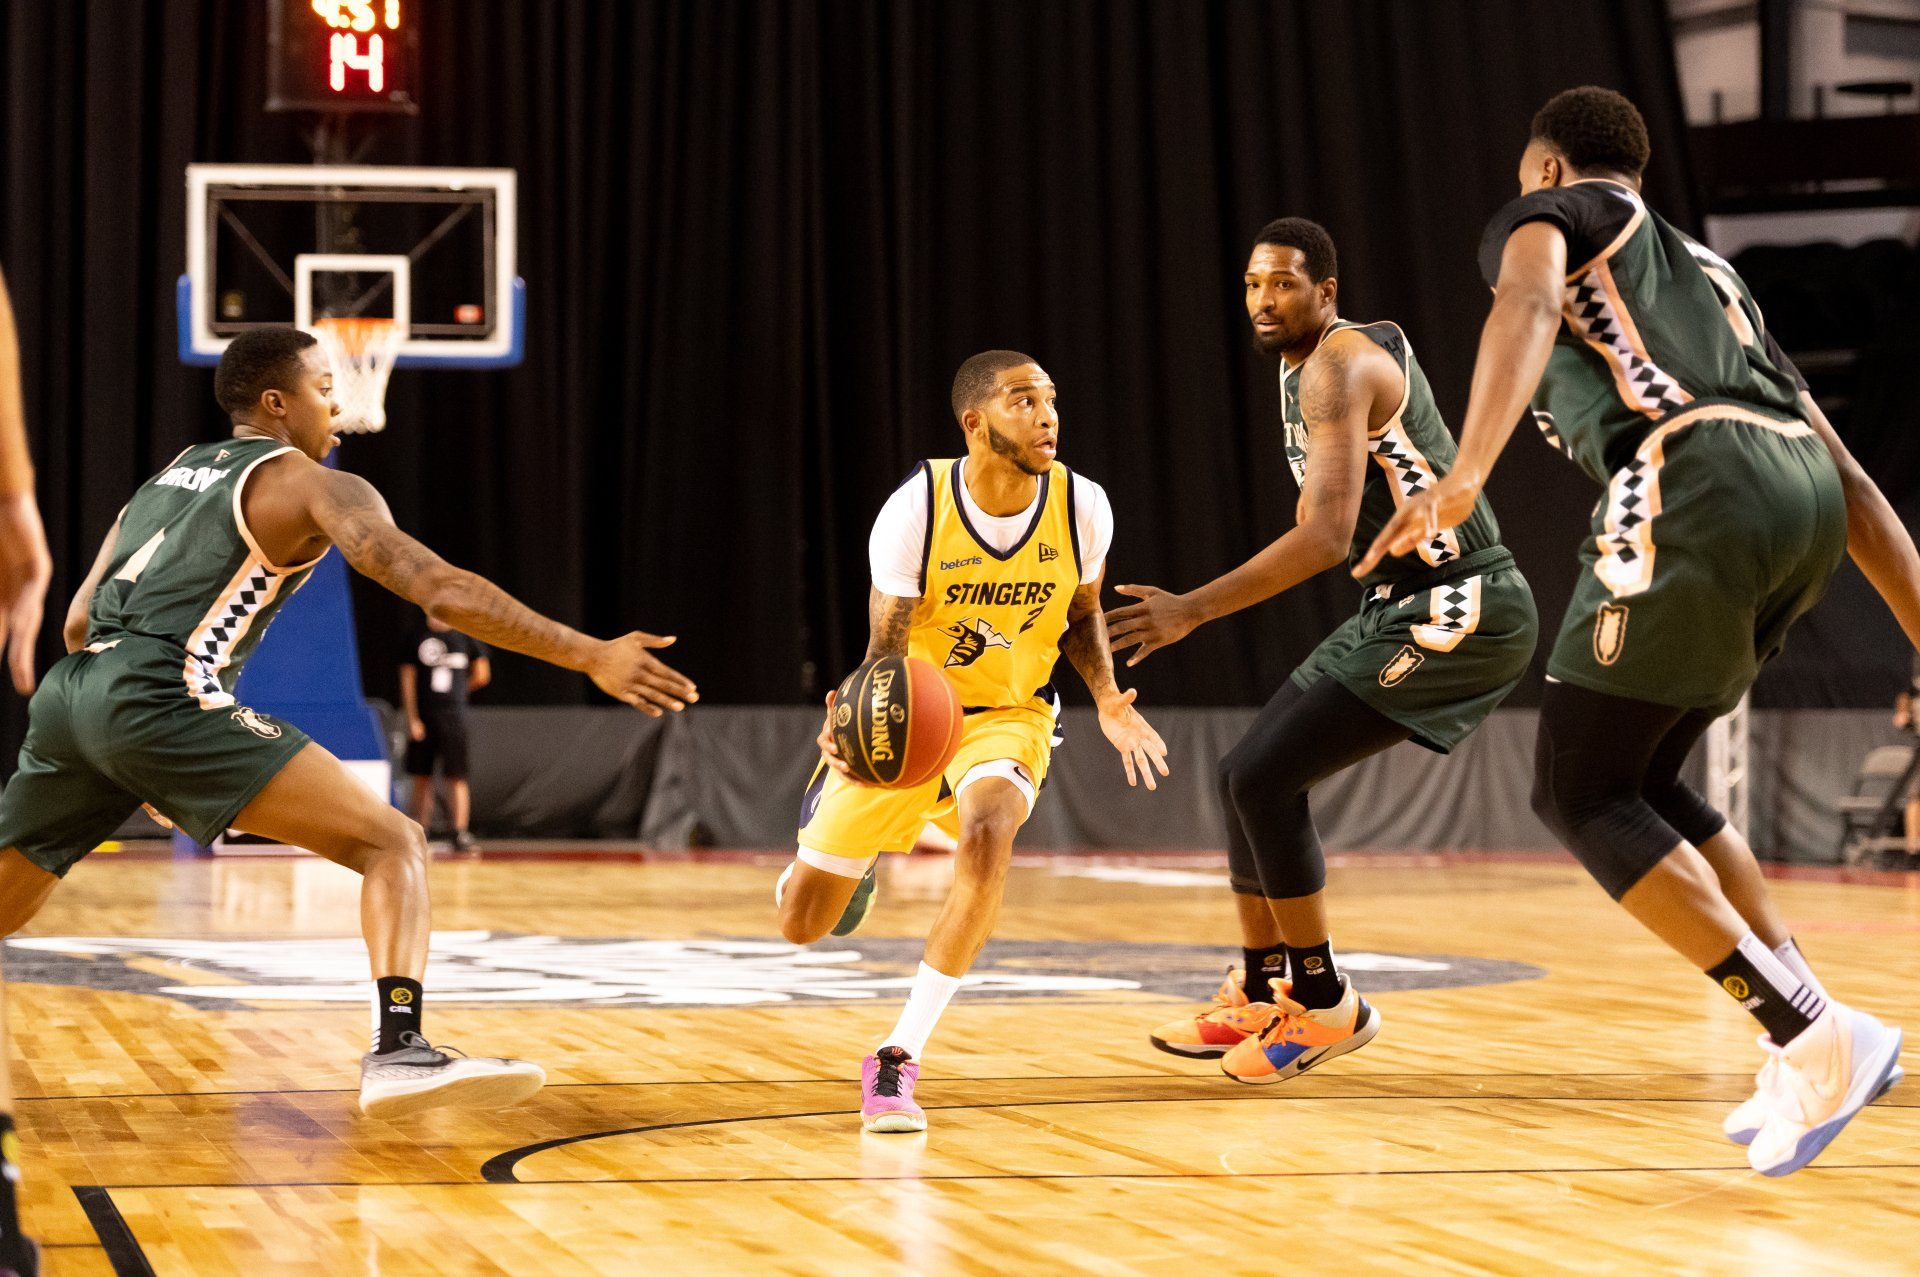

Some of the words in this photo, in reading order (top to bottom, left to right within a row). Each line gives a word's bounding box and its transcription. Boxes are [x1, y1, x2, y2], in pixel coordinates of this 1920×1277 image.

[329, 32, 384, 92] 14
[940, 555, 983, 571] betcris
[944, 581, 1057, 606] STINGERS
[1018, 604, 1046, 635] 2
[871, 668, 895, 765] SPALDING
